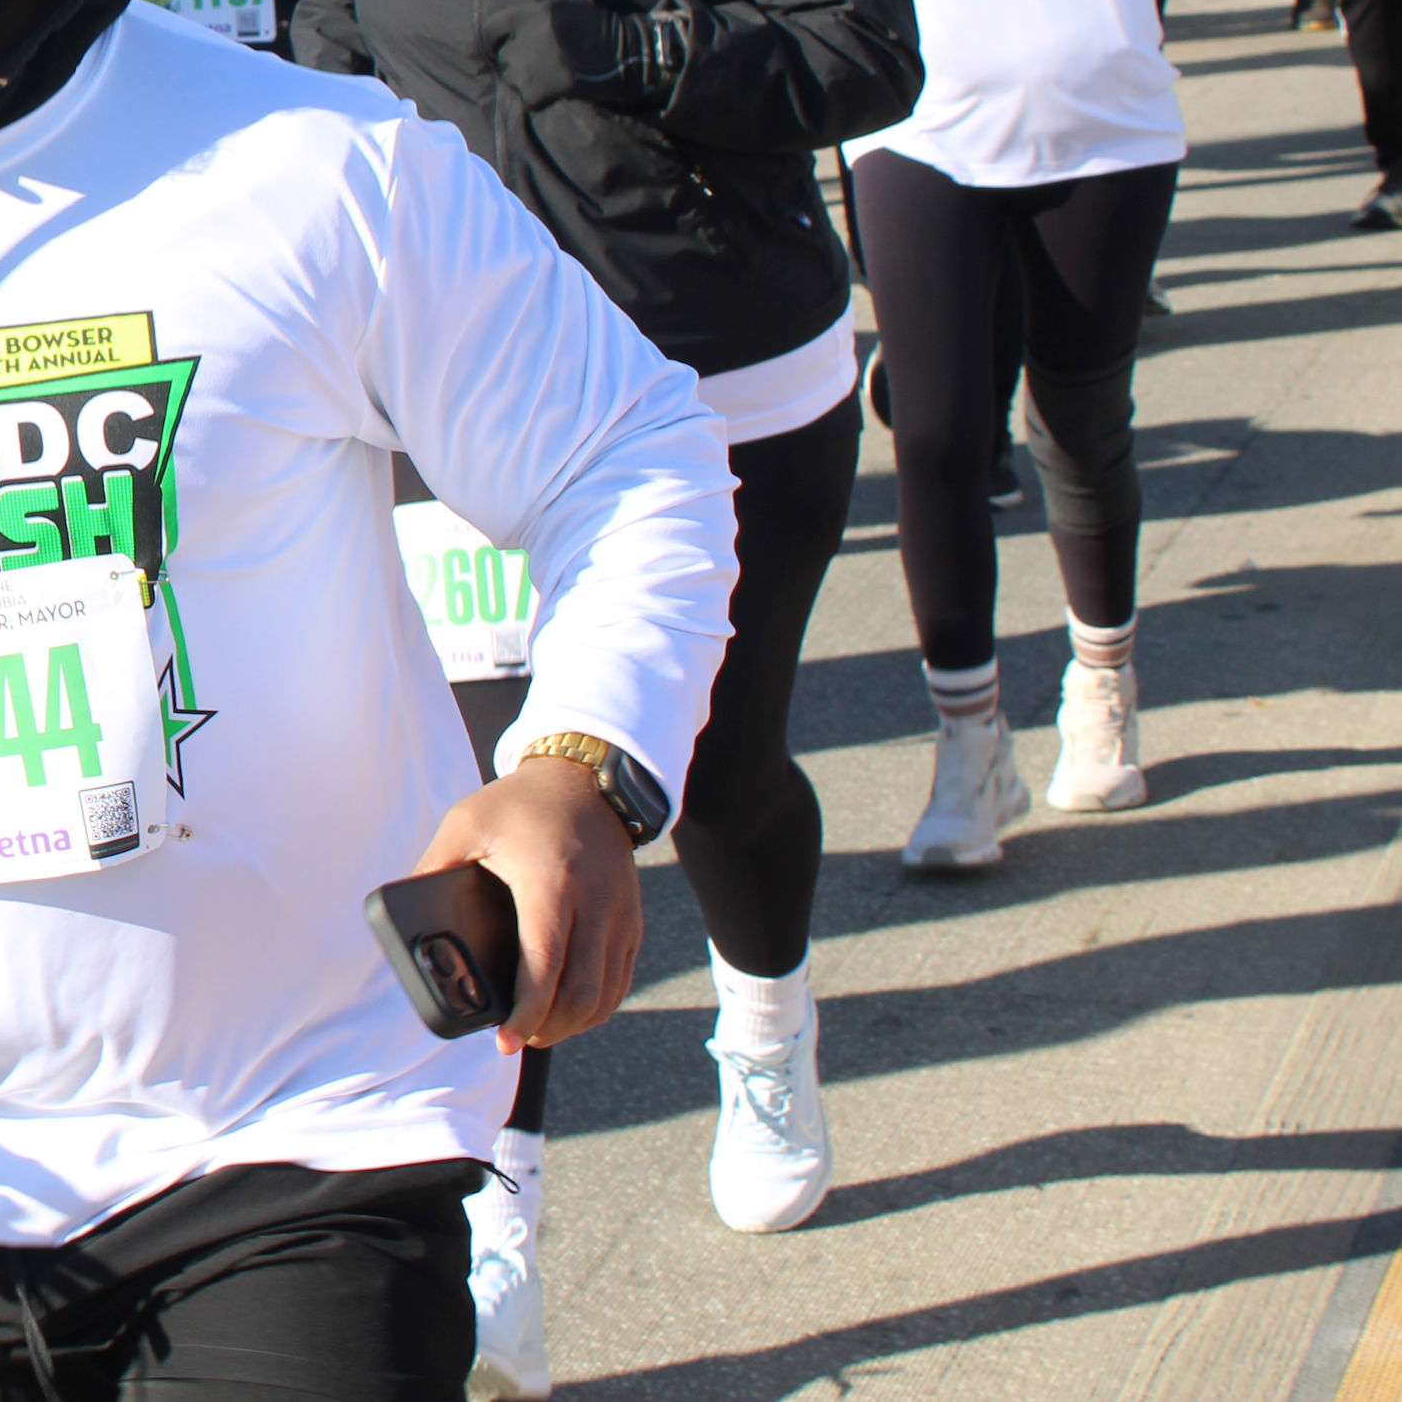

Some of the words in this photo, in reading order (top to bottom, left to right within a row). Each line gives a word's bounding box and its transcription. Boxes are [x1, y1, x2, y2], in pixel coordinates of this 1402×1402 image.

[5, 327, 113, 355] BOWSER
[28, 347, 121, 372] ANNUAL
[414, 544, 532, 627] 2607
[17, 599, 86, 630] MAYOR
